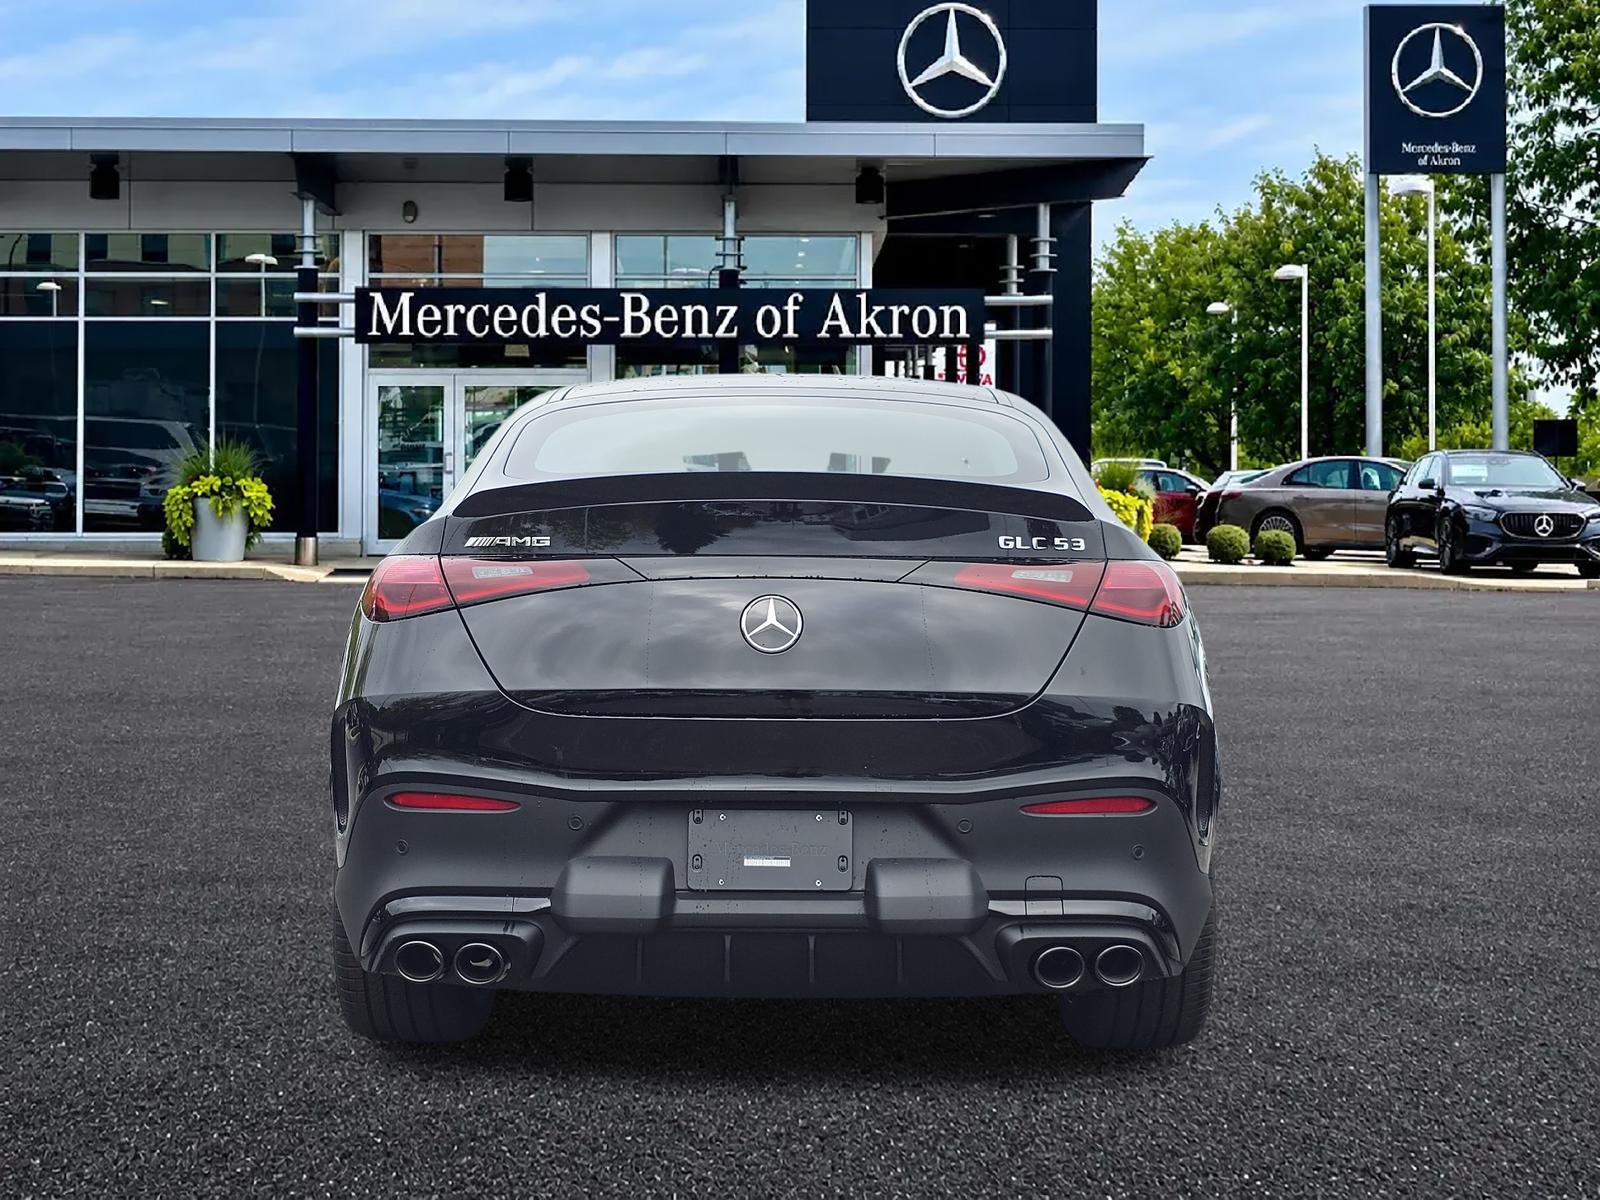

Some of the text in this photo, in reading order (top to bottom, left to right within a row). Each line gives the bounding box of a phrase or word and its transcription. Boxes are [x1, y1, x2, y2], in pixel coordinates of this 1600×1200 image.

[1401, 141, 1477, 154] Mercedes-Benz
[1417, 154, 1461, 166] of Akron
[367, 292, 970, 339] Mercedes-Benz of Akron
[493, 536, 551, 547] AMG
[998, 535, 1086, 551] GLC 53
